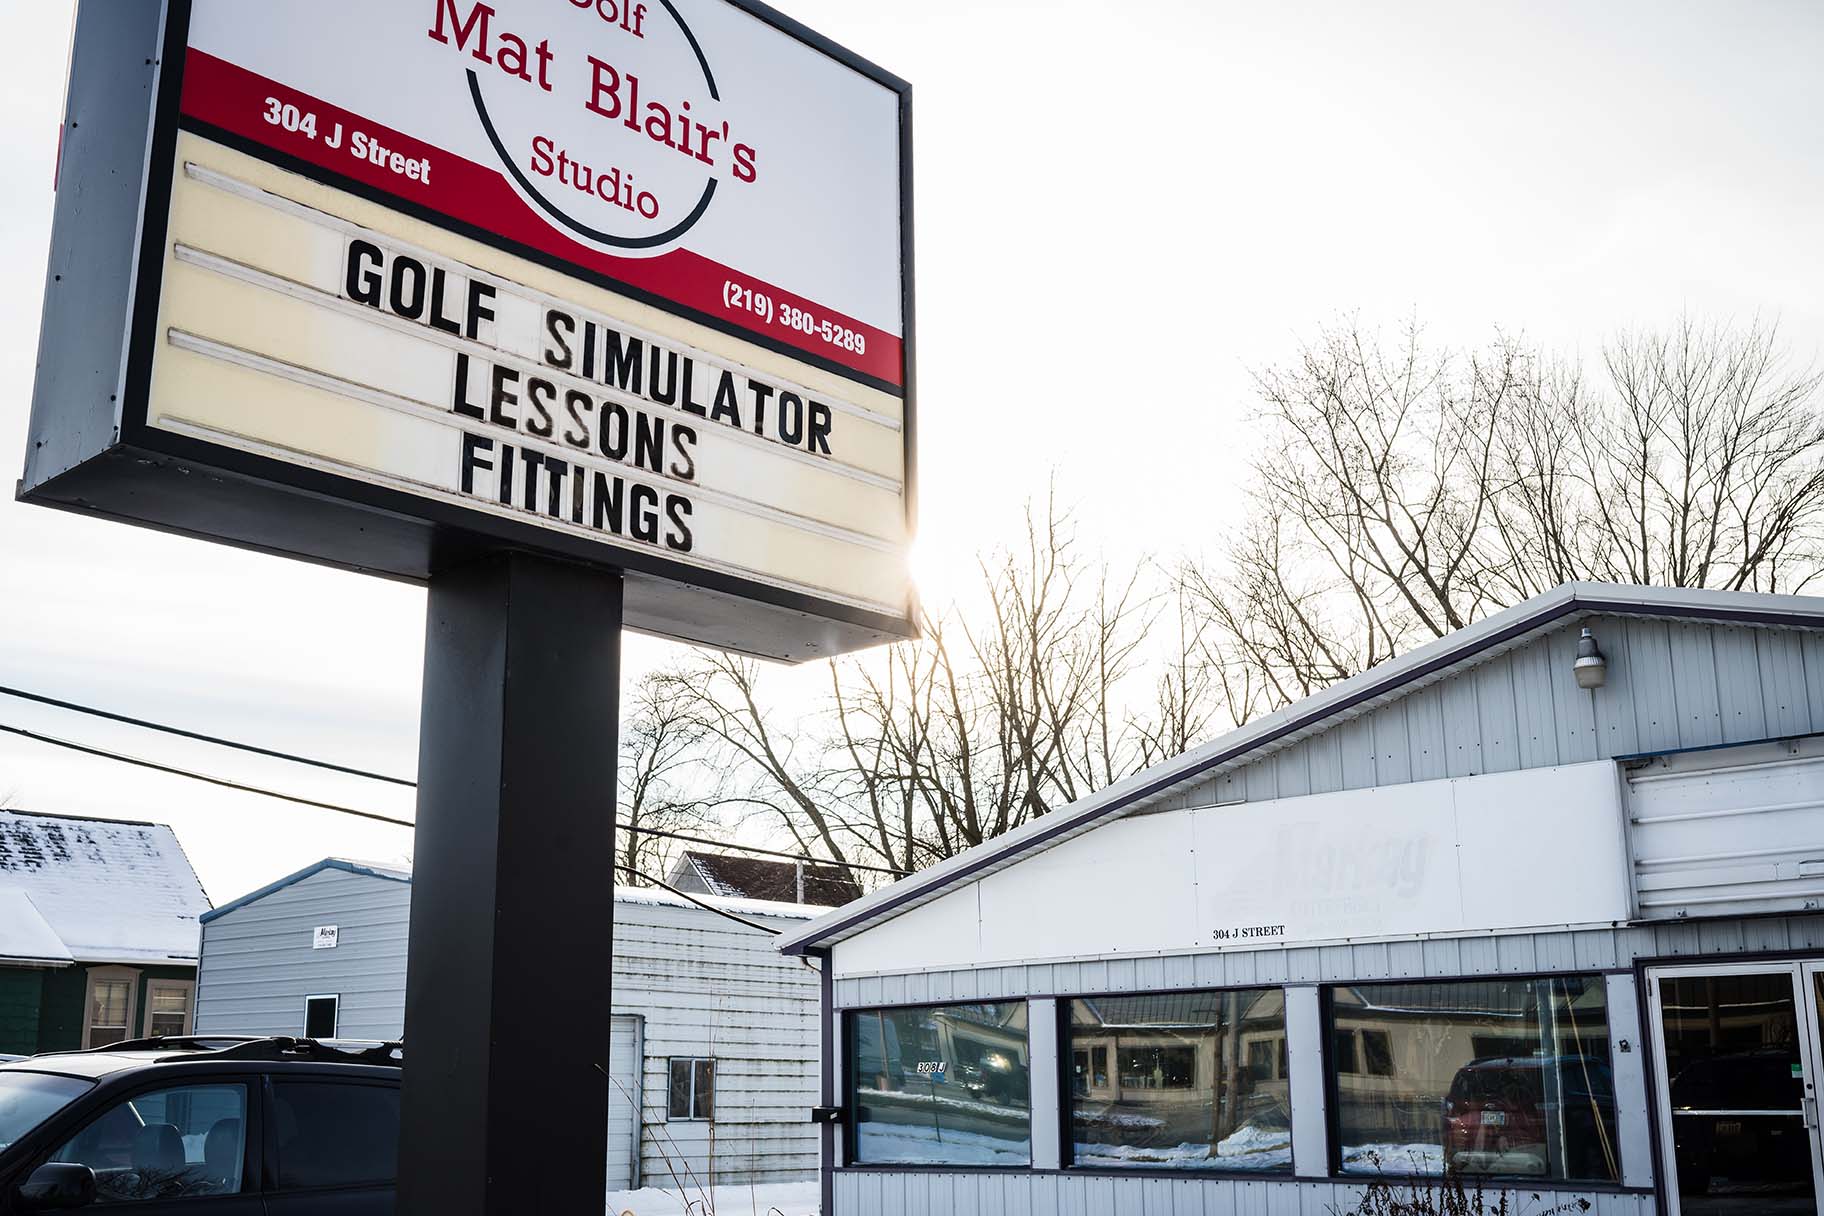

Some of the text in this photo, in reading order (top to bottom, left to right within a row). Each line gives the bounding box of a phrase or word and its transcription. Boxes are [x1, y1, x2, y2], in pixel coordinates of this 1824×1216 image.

[568, 0, 647, 38] olf
[428, 0, 757, 183] Mat Blair's
[263, 97, 431, 185] 304 J Street
[531, 136, 659, 219] Studio
[346, 239, 832, 455] GOLF SIMULATOR
[722, 281, 866, 355] (219) 380-5289
[454, 353, 697, 481] LESSONS
[462, 432, 693, 552] FITTINGS
[1213, 925, 1285, 940] 304 J STREET
